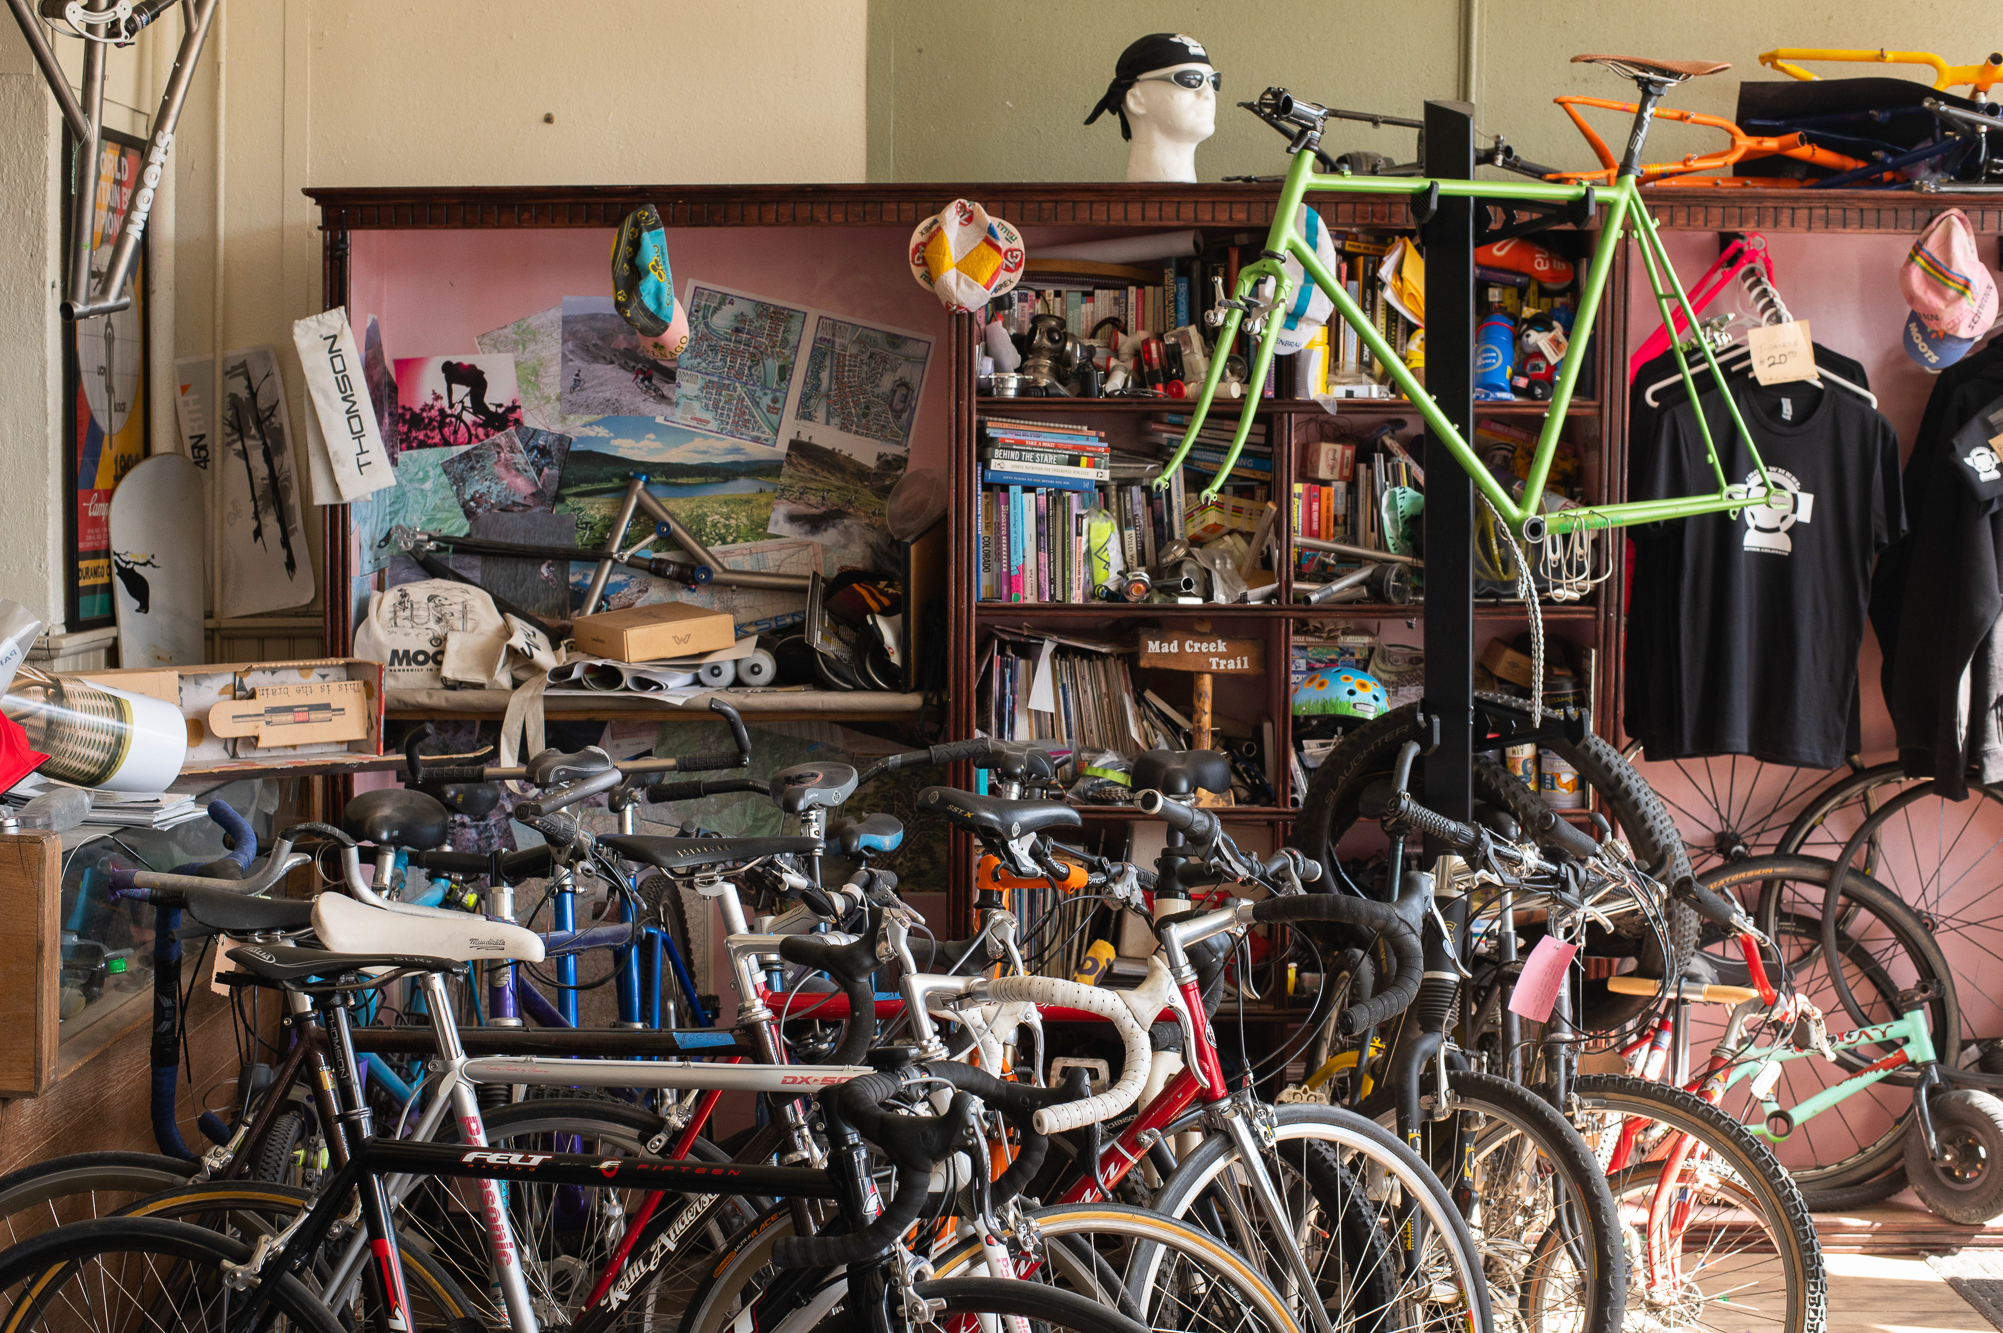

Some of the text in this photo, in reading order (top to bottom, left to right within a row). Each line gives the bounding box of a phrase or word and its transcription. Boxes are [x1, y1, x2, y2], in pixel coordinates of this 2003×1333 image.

[100, 151, 129, 181] ORLD
[126, 130, 174, 241] MOOTS
[1177, 282, 1188, 321] Bicycling
[1967, 282, 1994, 332] SCHWINN
[642, 335, 689, 360] OLNAGO
[1908, 322, 1940, 364] MOOTS
[323, 333, 372, 476] THOMSON
[994, 448, 1058, 465] BEHIND THE STARE
[1219, 454, 1254, 468] BING
[1768, 465, 1801, 490] WHEEL
[82, 492, 110, 521] Camp
[982, 535, 991, 573] COLORADO
[735, 609, 807, 638] KSEN
[388, 649, 445, 667] MOO
[1147, 639, 1227, 653] Mad Creek
[1208, 656, 1250, 669] Trail
[258, 682, 361, 699] This is the brain
[1324, 724, 1409, 806] SLAUGHTER
[1047, 855, 1067, 875] yncros
[1709, 867, 1774, 890] GATORSKIN
[327, 1009, 347, 1081] THOMSON
[1103, 1113, 1138, 1131] TCHINSO
[461, 1150, 554, 1167] FELT
[467, 1162, 536, 1172] RACING
[637, 1163, 741, 1177] FIFTEEN
[458, 1115, 516, 1268] Paasonic
[751, 1212, 780, 1239] RACE
